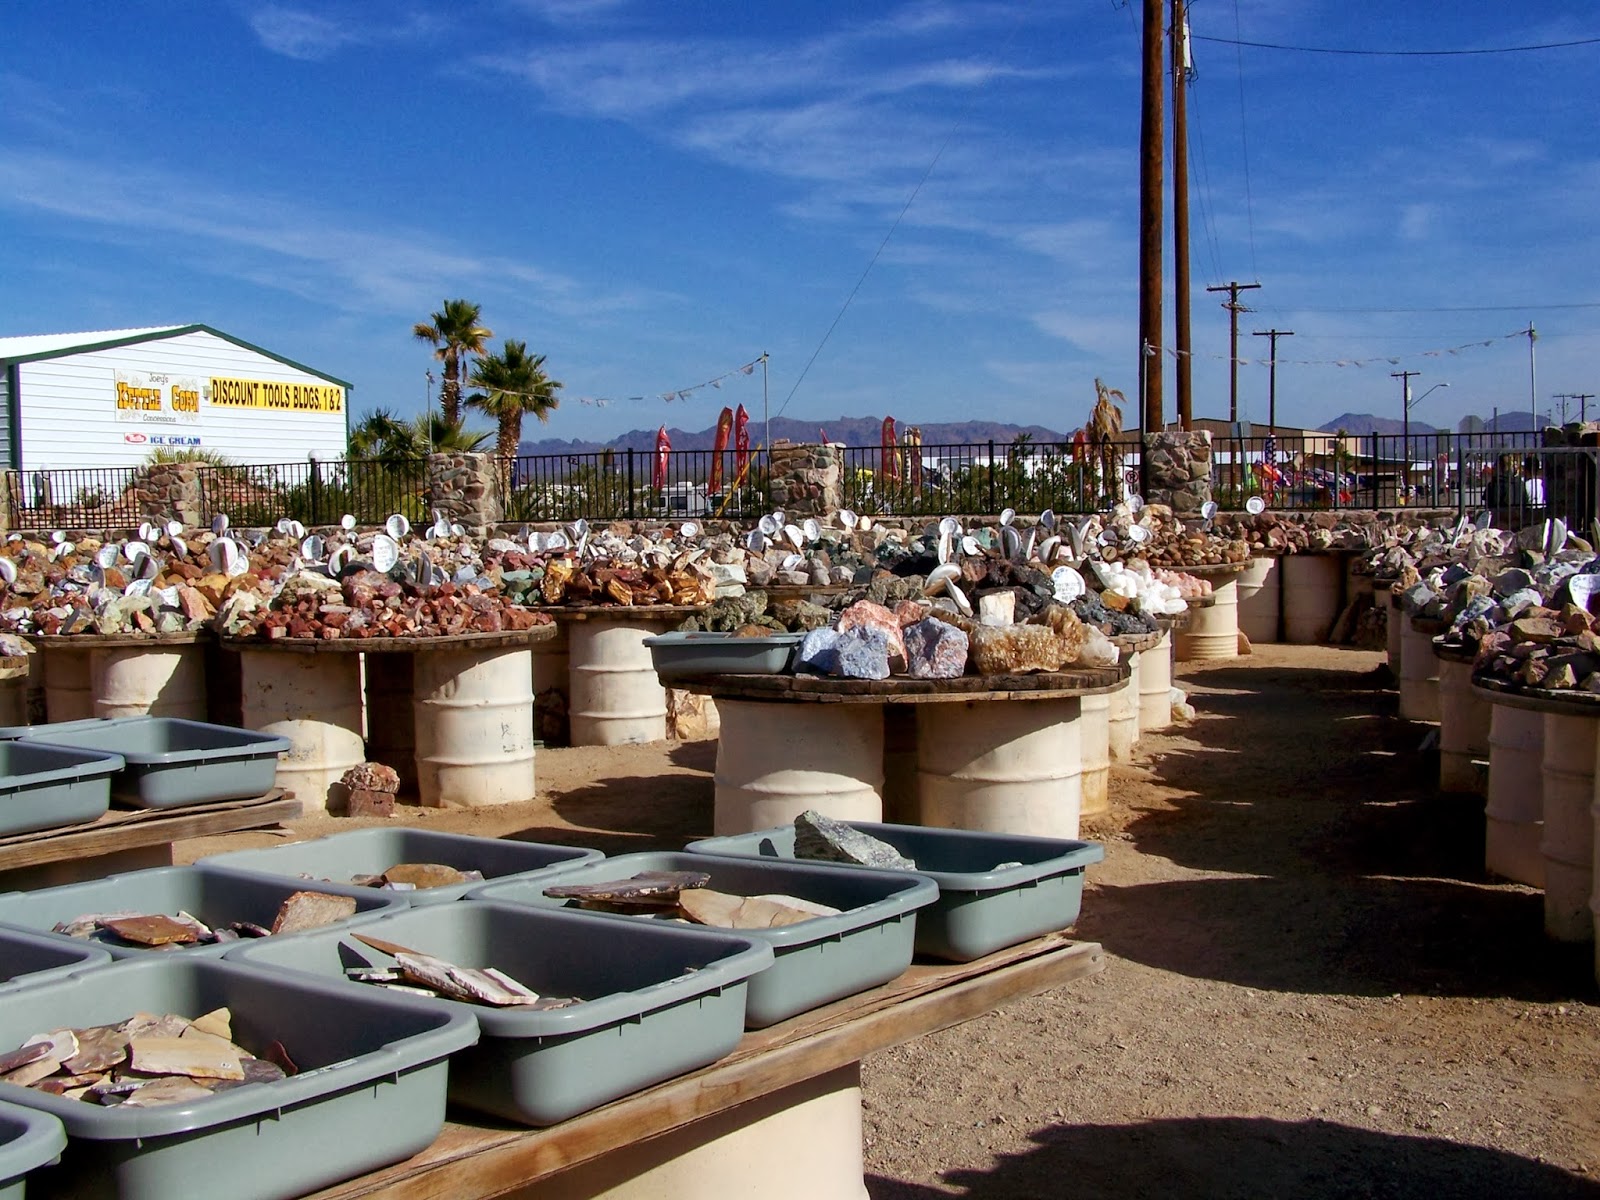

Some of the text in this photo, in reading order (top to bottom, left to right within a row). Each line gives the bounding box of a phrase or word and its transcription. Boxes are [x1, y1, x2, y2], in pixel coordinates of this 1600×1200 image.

[212, 379, 341, 411] DISCOUNT TOOLS BLDGS. 1 & 2
[150, 436, 165, 444] ICE
[168, 436, 201, 445] CREAM
